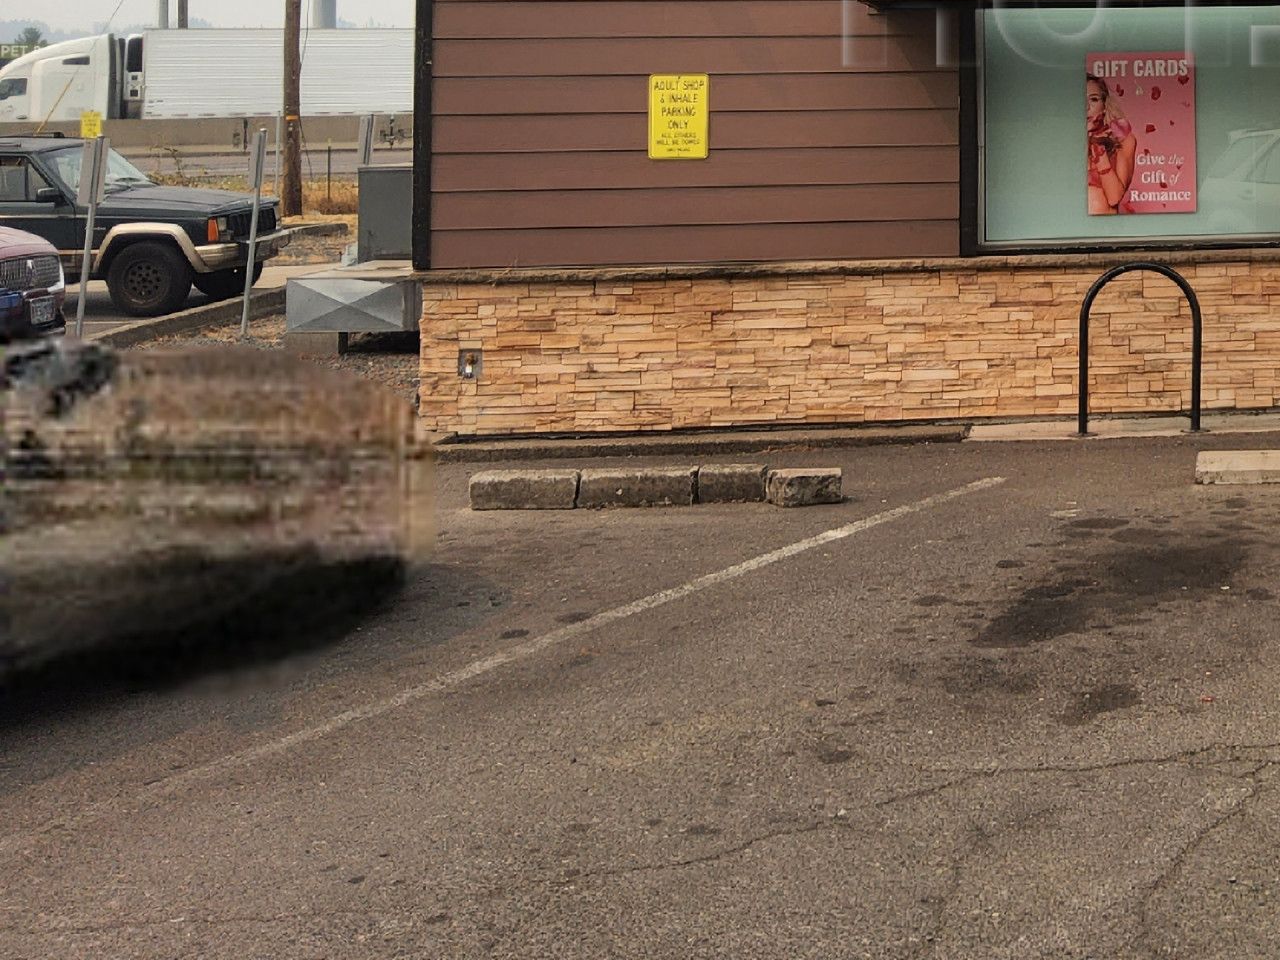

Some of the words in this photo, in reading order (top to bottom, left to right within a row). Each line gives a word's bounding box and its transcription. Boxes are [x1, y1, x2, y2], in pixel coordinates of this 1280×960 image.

[1093, 60, 1129, 78] GIFT
[1133, 59, 1189, 77] CARDS
[654, 80, 679, 91] ADULT
[683, 80, 705, 91] SHOP
[669, 93, 699, 104] INHALE
[662, 107, 697, 117] PARKING
[668, 120, 689, 130] ONLY
[1136, 153, 1165, 165] Give
[1168, 153, 1185, 165] the
[1141, 170, 1165, 184] Gift
[1169, 171, 1180, 185] of
[1130, 189, 1192, 202] Romance
